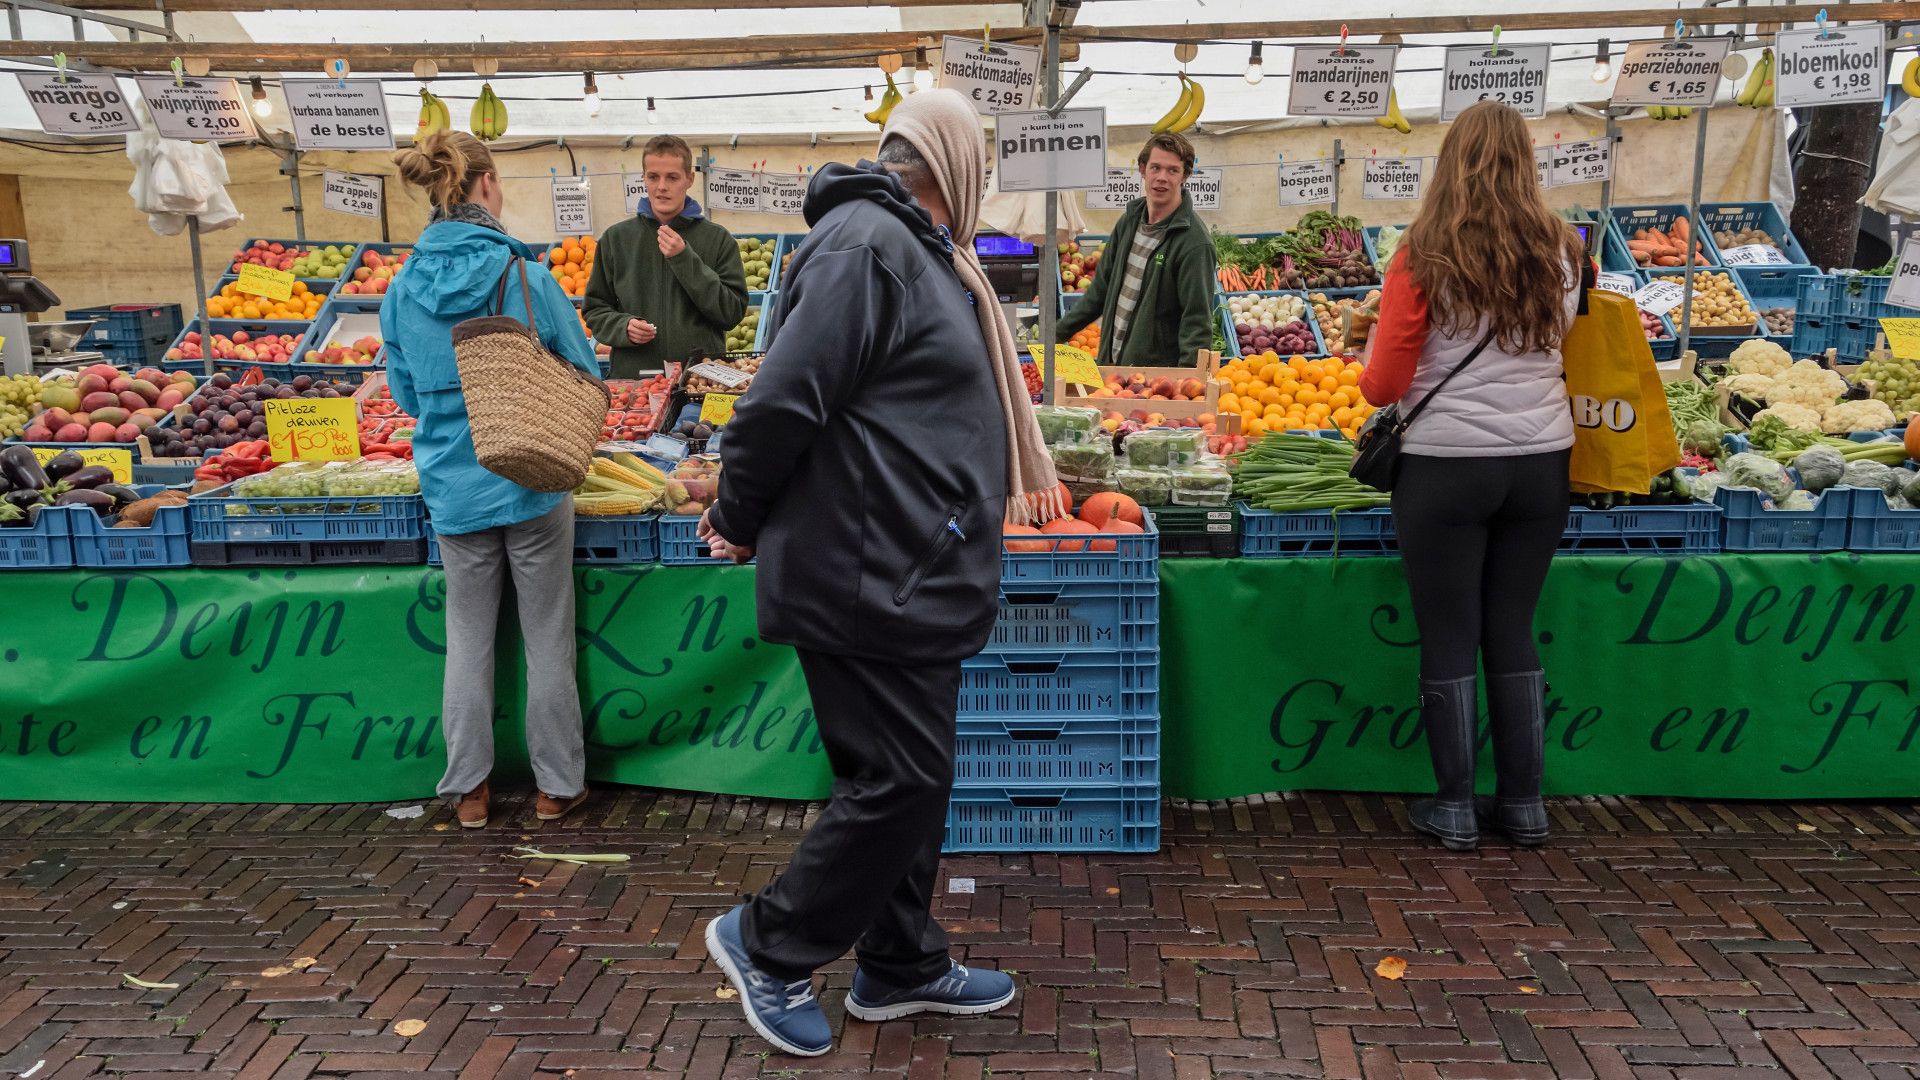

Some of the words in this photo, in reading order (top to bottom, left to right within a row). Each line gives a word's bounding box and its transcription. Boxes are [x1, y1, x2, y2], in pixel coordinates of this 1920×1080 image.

[965, 52, 1021, 66] hollandse
[1469, 58, 1529, 67] hollandse
[1781, 46, 1878, 76] bloemkool
[945, 61, 1033, 89] snacktomaatjes
[1622, 58, 1720, 78] sperziebonen
[1295, 66, 1389, 87] mandarijnen
[1448, 66, 1544, 91] trostomaten
[1813, 76, 1825, 89] €
[1831, 73, 1871, 90] 1,98
[1648, 81, 1661, 92] €
[1666, 81, 1706, 96] 1,65
[28, 89, 121, 109] mango
[971, 87, 983, 101] €
[987, 89, 1023, 106] 2,95
[1324, 90, 1335, 102] €
[1340, 91, 1379, 106] 2,50
[1495, 90, 1534, 106] 2,95
[148, 95, 240, 114] wijnprijmen
[293, 105, 333, 116] turbana
[334, 105, 379, 116] bananen
[69, 112, 81, 123] €
[85, 111, 123, 125] 4,00
[187, 117, 198, 128] €
[202, 117, 240, 130] 2,00
[311, 124, 331, 136] de
[336, 124, 385, 136] beste
[1001, 133, 1101, 159] pinnen
[1554, 150, 1607, 168] prei
[1366, 170, 1419, 183] bosbieten
[1581, 165, 1604, 175] 1,99
[1186, 180, 1220, 192] emkool
[1281, 174, 1332, 187] bospeen
[326, 181, 344, 194] jazz
[347, 187, 378, 199] appels
[710, 182, 759, 196] conference
[780, 188, 805, 199] orange
[1299, 189, 1305, 197] €
[1308, 187, 1329, 197] 1,98
[1392, 185, 1414, 193] 1,98
[351, 200, 373, 209] 2,98
[733, 196, 755, 205] 2,98
[781, 200, 802, 209] 2,98
[1114, 194, 1135, 203] 2,50
[1195, 193, 1215, 202] 1,98
[567, 214, 583, 222] 3,99
[1597, 282, 1633, 294] seval
[267, 402, 317, 415] Pitloze
[1575, 395, 1636, 433] BO
[1616, 554, 1915, 662] Deijn
[71, 570, 347, 674] Deijn
[1270, 679, 1603, 773] Grote
[1650, 706, 1749, 753] en
[130, 714, 212, 760] en
[246, 691, 440, 779] Fru
